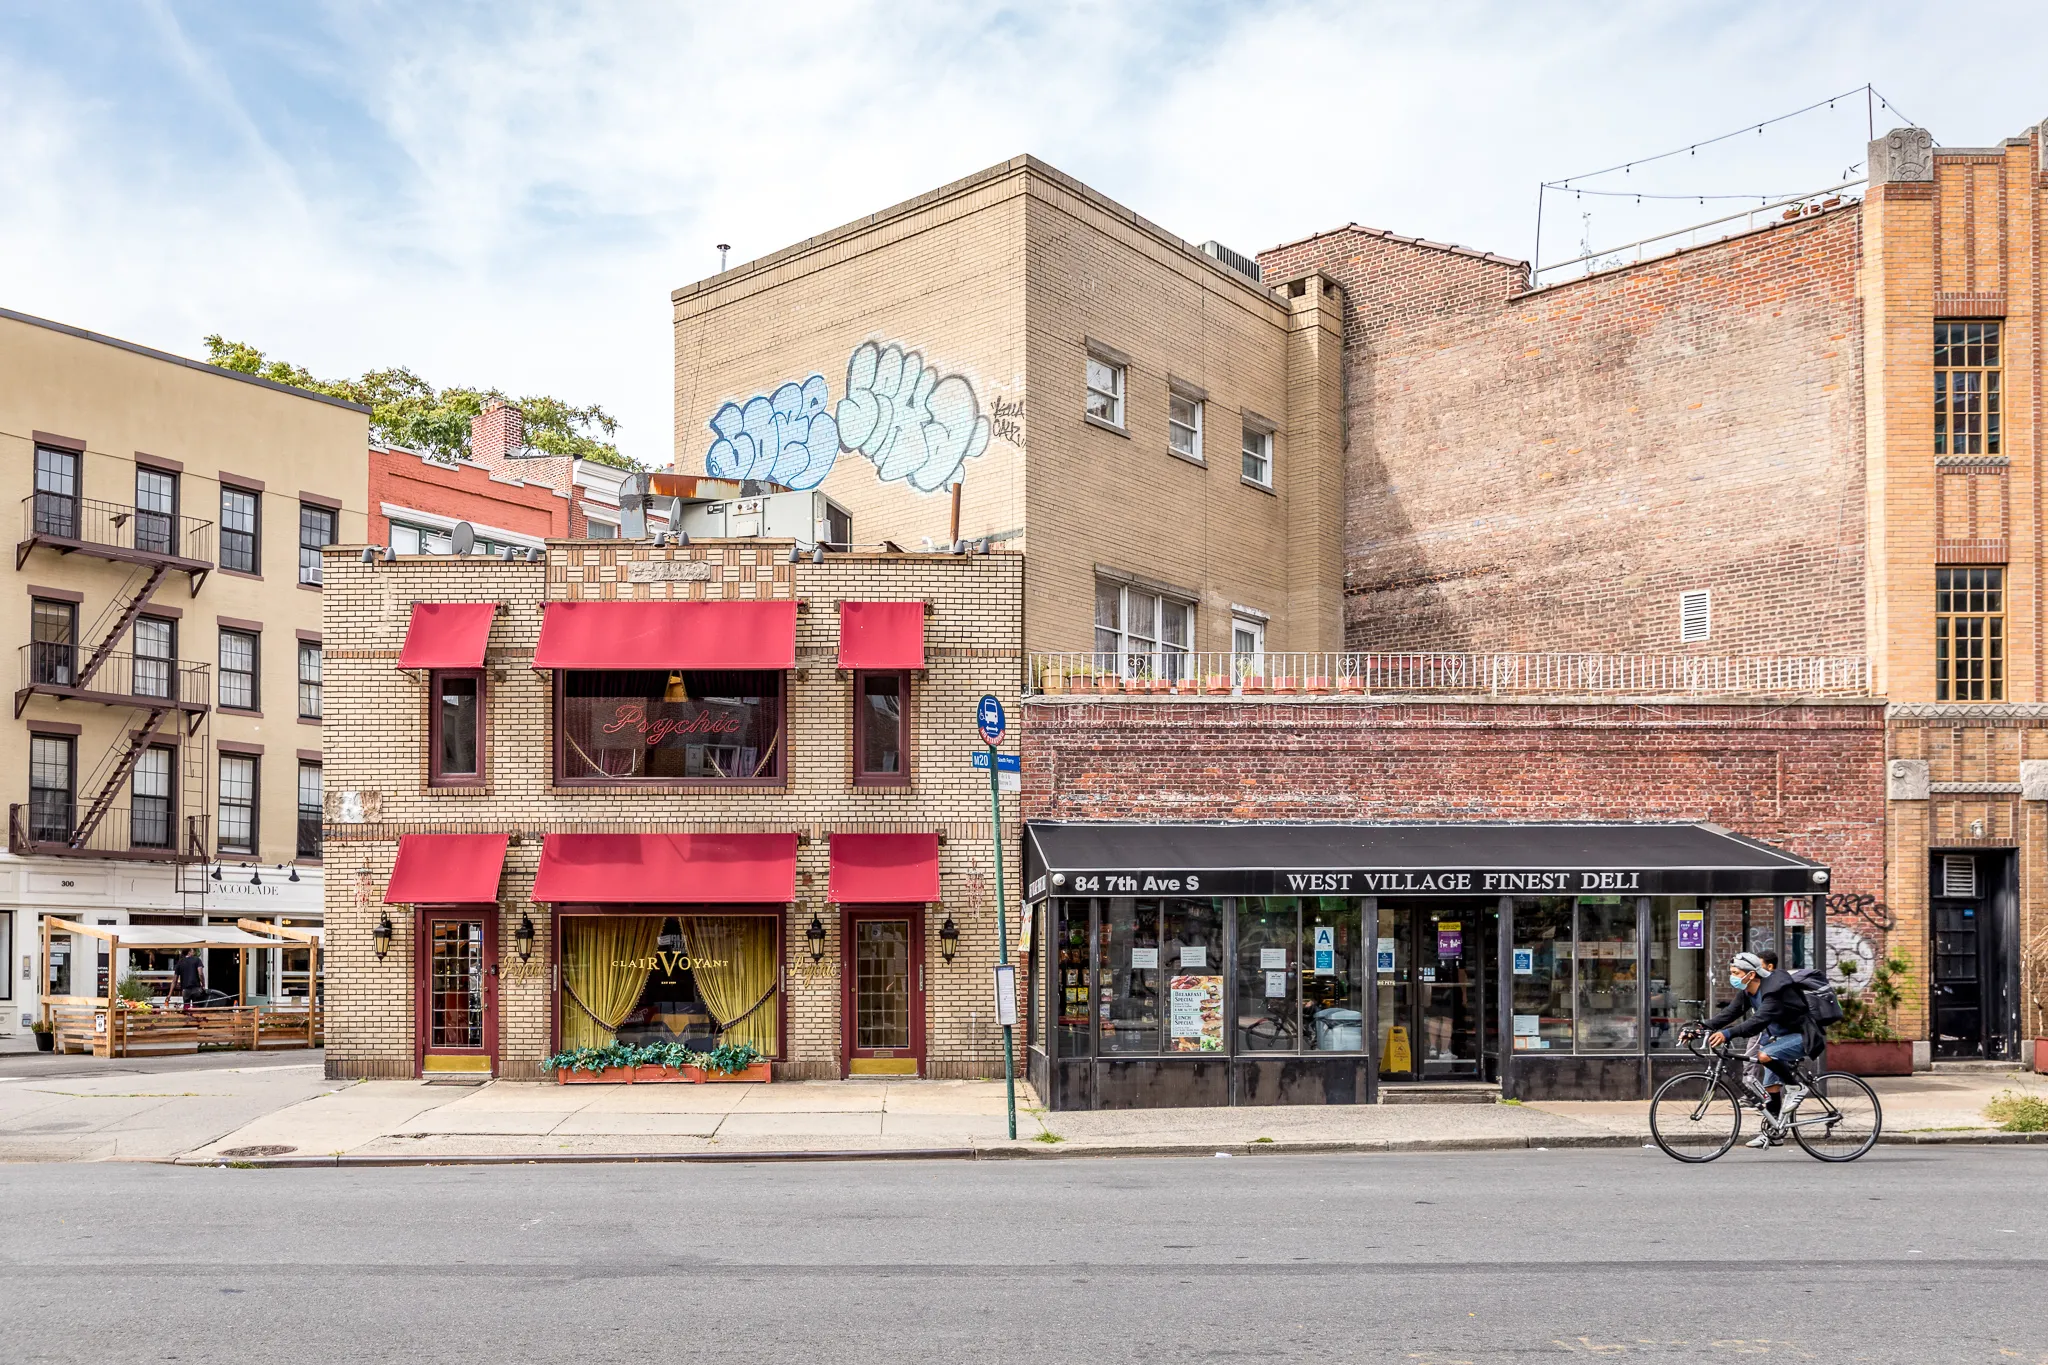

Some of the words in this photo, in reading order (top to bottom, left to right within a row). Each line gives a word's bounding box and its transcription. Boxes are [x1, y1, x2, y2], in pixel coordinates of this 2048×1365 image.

[602, 704, 740, 745] Psychic
[973, 754, 989, 767] M20
[61, 880, 75, 888] 300
[1074, 876, 1100, 891] 84
[1105, 876, 1137, 891] 7th
[1143, 876, 1180, 891] Ave
[1186, 875, 1200, 891] S
[1286, 873, 1353, 891] WEST
[1364, 873, 1472, 891] VILLAGE
[1482, 873, 1570, 890] FINEST
[1580, 872, 1640, 890] DELI
[1317, 929, 1331, 944] A
[499, 956, 547, 988] Psychic
[789, 952, 837, 988] Psychic
